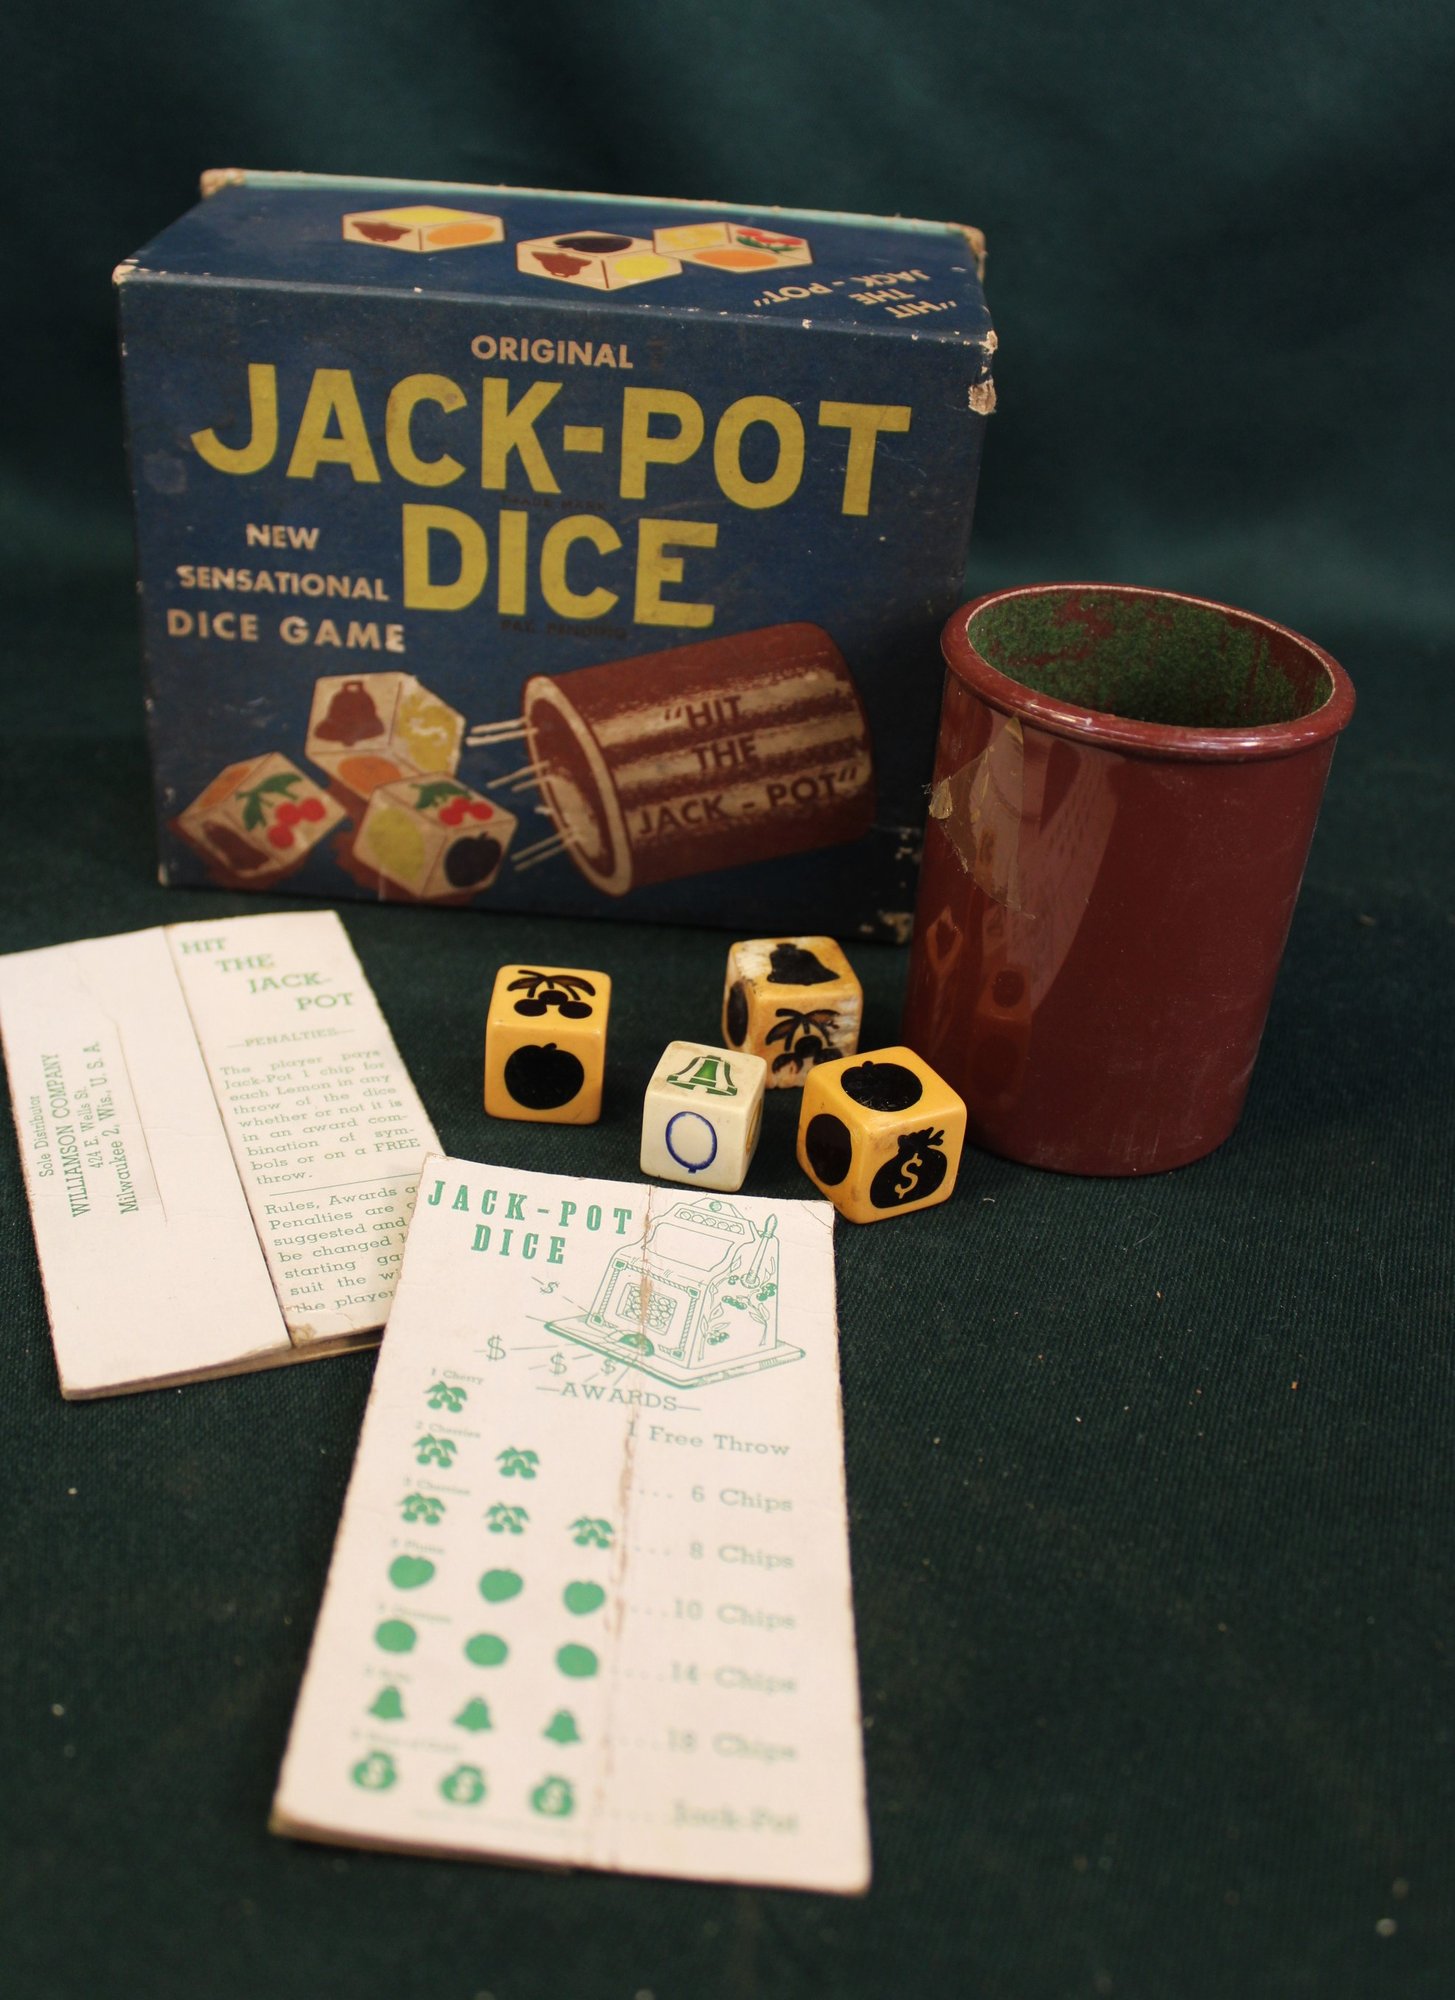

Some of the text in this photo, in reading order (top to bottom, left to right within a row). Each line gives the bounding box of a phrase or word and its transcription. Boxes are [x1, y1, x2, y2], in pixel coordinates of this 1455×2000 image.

[849, 288, 915, 305] THE
[470, 335, 634, 370] ORIGINAL
[191, 363, 911, 517] JACK-POT
[246, 523, 320, 550] NEW
[402, 503, 719, 629] DICE
[176, 565, 390, 601] SENSATIONAL
[167, 608, 406, 653] DICE GAME
[663, 695, 742, 729] "HIT
[692, 736, 756, 770] THE
[180, 937, 226, 954] HIT
[215, 953, 275, 972] THE
[296, 993, 353, 1010] POT
[219, 1049, 381, 1076] The player pays
[224, 1061, 386, 1090] Jack-Pot 1 chip for
[229, 1074, 391, 1102] each Lemon in any
[233, 1085, 397, 1115] throw of the dice
[78, 1101, 95, 1132] Wells
[238, 1099, 402, 1129] whether or not it is
[242, 1114, 408, 1142] in an award com-
[29, 1095, 54, 1178] Sole Distributor
[41, 1053, 91, 1217] WILLIAMSON COMPANY
[246, 1127, 415, 1157] bination of sym-
[251, 1138, 421, 1171] bols or on a FREE
[108, 1140, 139, 1214] Milwaukee
[256, 1170, 313, 1185] throw.
[264, 1200, 320, 1216] Rules,
[329, 1184, 398, 1206] Awards
[428, 1180, 634, 1235] JACK-POT
[269, 1211, 353, 1231] Penalties
[365, 1205, 395, 1217] are
[273, 1217, 407, 1247] suggested and
[278, 1251, 302, 1263] be
[312, 1236, 392, 1258] changed
[471, 1224, 566, 1264] DICE
[284, 1259, 357, 1279] starting
[290, 1275, 367, 1296] suit the
[485, 1335, 506, 1361] $
[443, 1369, 484, 1385] Cherry
[549, 1352, 568, 1376] $
[627, 1421, 791, 1456] 1 Free Throw
[691, 1485, 793, 1514] 6 Chips
[690, 1541, 795, 1570] 8 Chips
[674, 1598, 797, 1629] 10 Chips
[714, 1664, 797, 1695] Chips
[712, 1731, 798, 1763] Chips
